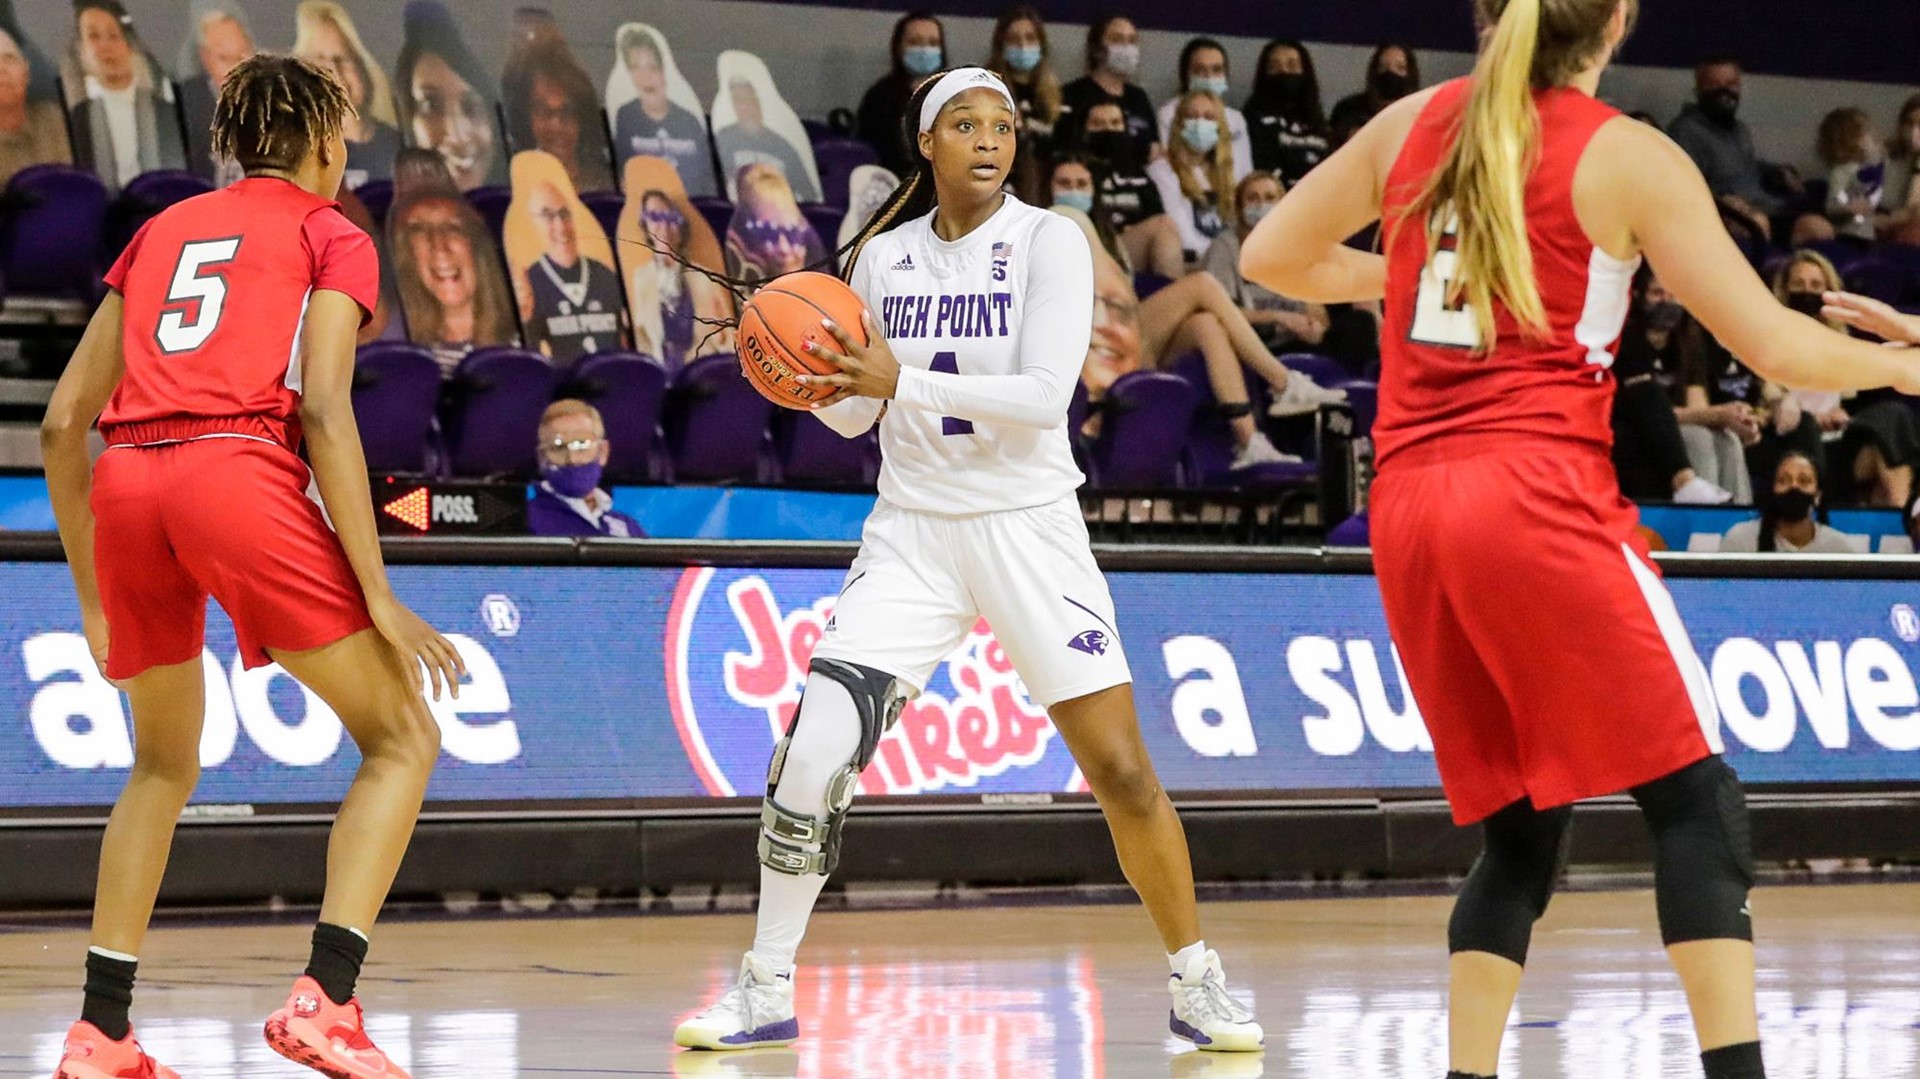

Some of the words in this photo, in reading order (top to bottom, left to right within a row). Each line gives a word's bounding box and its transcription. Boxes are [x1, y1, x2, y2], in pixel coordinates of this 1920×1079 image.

[154, 234, 244, 355] 5
[891, 263, 915, 271] adidas
[882, 295, 932, 339] HIGH
[934, 292, 1011, 338] POINT
[432, 495, 478, 523] POSS.
[21, 632, 522, 768] aoe
[1162, 634, 1257, 757] a
[1286, 635, 1435, 757] su
[1698, 637, 1920, 752] ove
